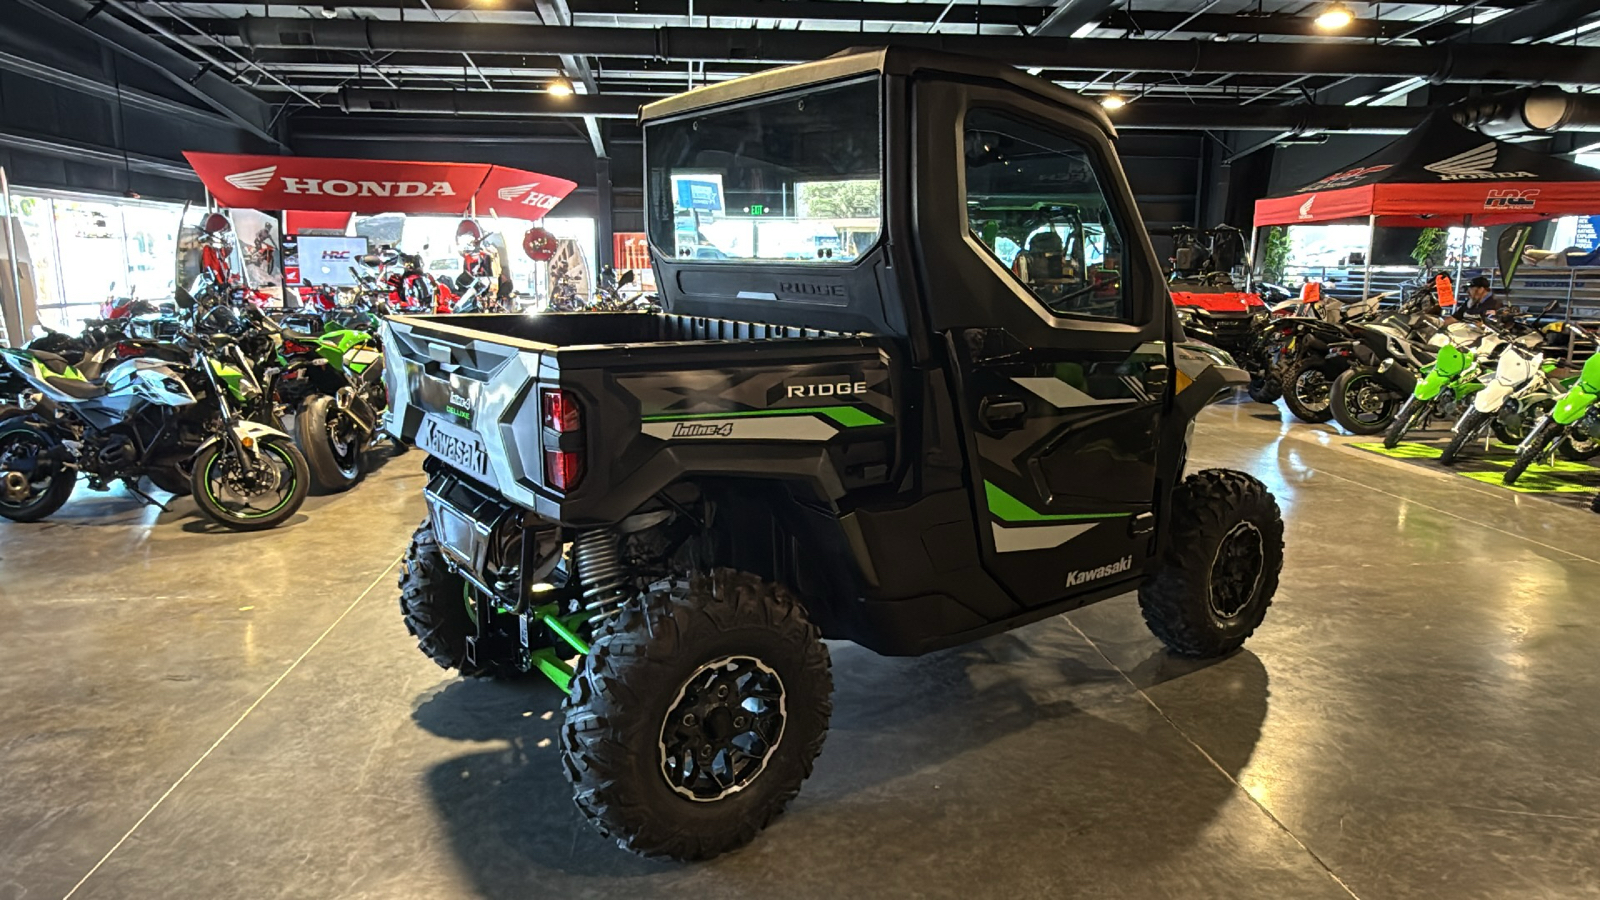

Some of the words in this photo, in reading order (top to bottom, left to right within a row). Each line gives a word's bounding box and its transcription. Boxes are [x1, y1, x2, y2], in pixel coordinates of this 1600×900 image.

[1438, 171, 1539, 180] HONDA
[280, 177, 456, 197] HONDA
[1484, 189, 1540, 206] HRC
[321, 250, 350, 259] HRC
[780, 282, 845, 297] RIDGE
[787, 382, 867, 398] RIDGE
[446, 405, 471, 420] DELUXE
[672, 422, 734, 438] Inline-4
[424, 418, 488, 476] Kawasaki
[1065, 554, 1133, 588] Kawasaki
